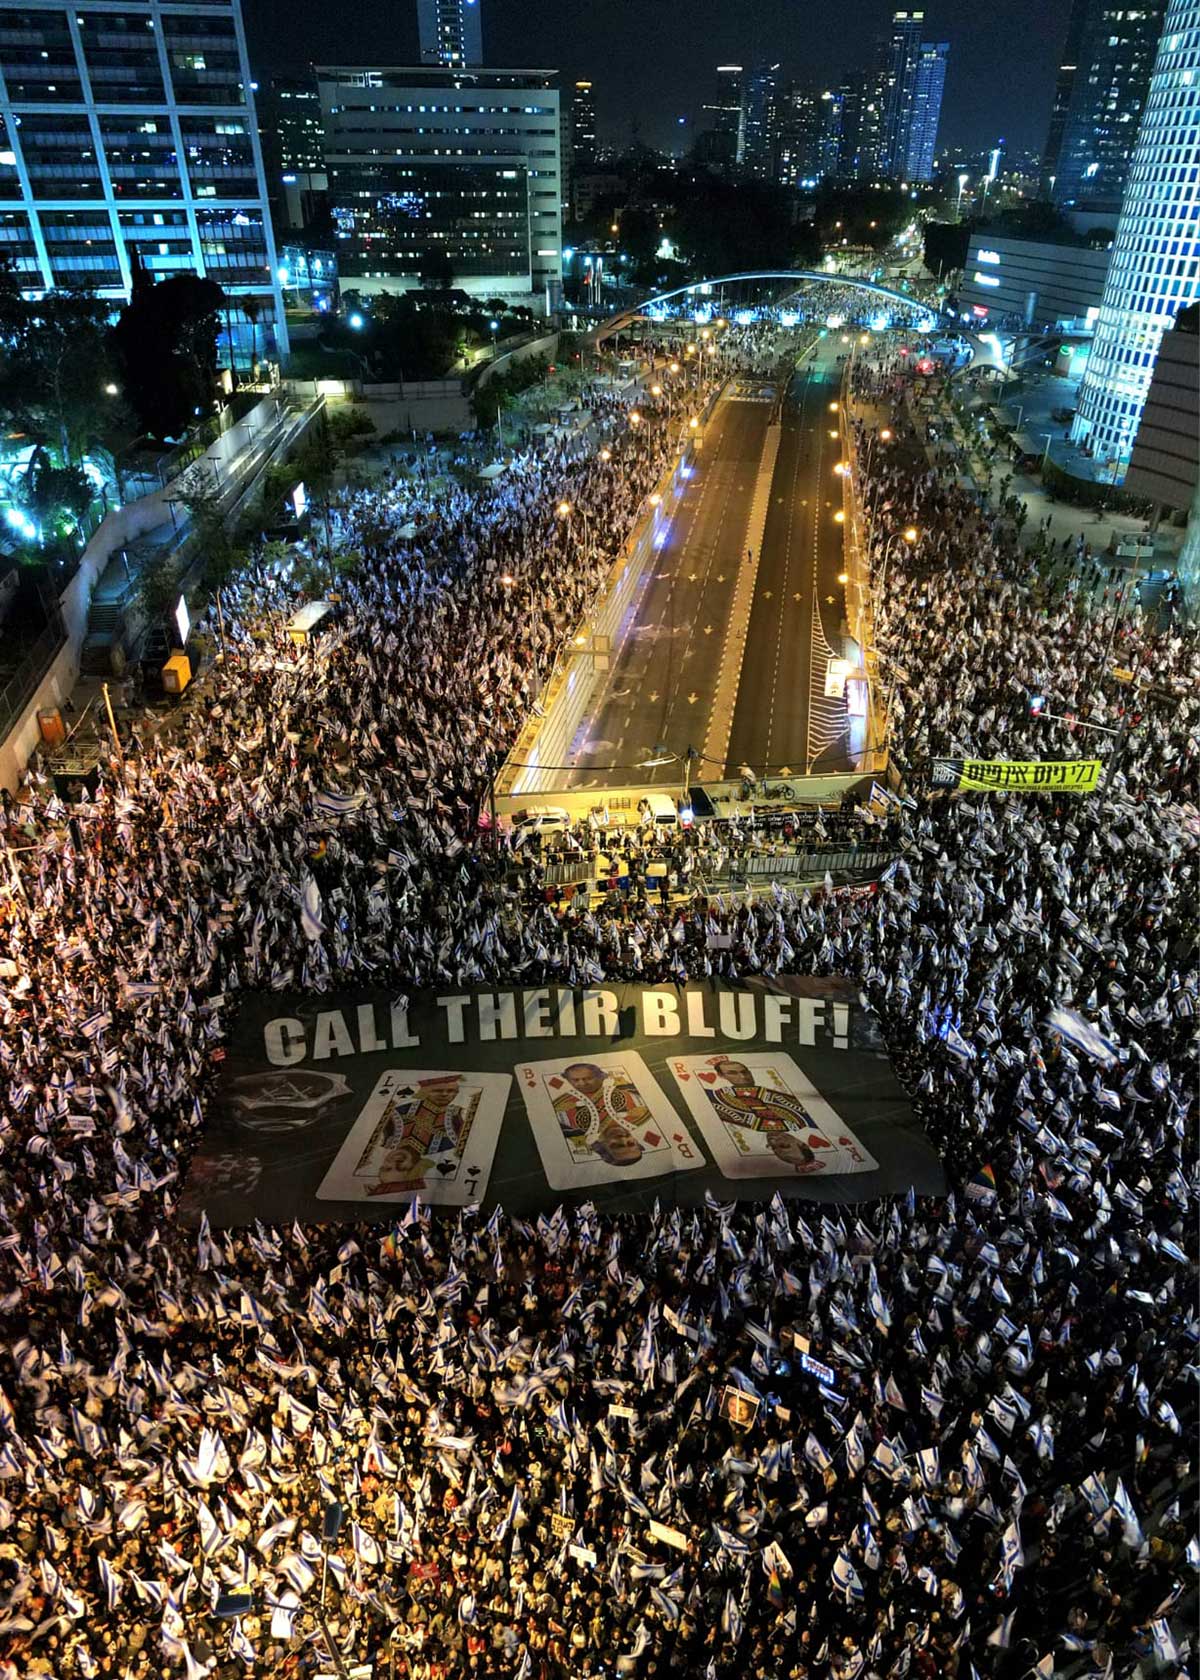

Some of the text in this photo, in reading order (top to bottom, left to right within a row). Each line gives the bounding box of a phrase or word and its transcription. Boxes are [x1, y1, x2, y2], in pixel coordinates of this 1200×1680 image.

[1004, 765, 1029, 785] אין
[1071, 764, 1095, 783] בלי
[263, 988, 849, 1066] CALL THEIR BLUFF!
[522, 1068, 535, 1080] B
[674, 1063, 687, 1073] R
[383, 1076, 393, 1087] L
[677, 1144, 695, 1158] B
[847, 1147, 865, 1163] R
[464, 1179, 479, 1197] L
